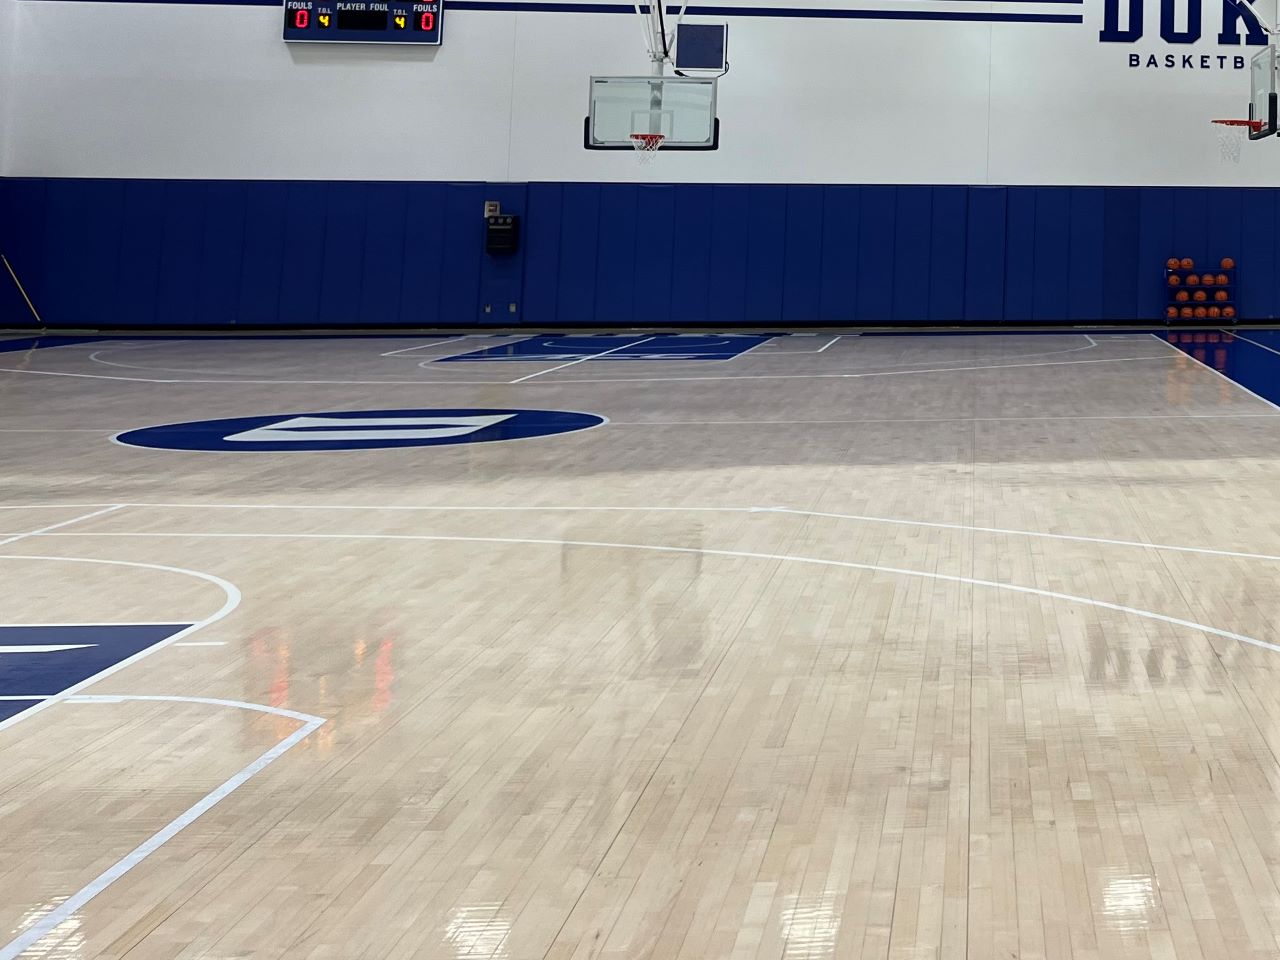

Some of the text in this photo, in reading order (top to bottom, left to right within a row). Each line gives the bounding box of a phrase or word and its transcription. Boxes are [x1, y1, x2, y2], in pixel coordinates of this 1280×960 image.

[288, 2, 313, 10] FOULS
[336, 3, 366, 11] PLAYER
[413, 4, 438, 12] FOULS
[295, 10, 309, 28] 0
[319, 15, 330, 27] 4
[395, 17, 405, 28] 4
[421, 12, 434, 30] 0
